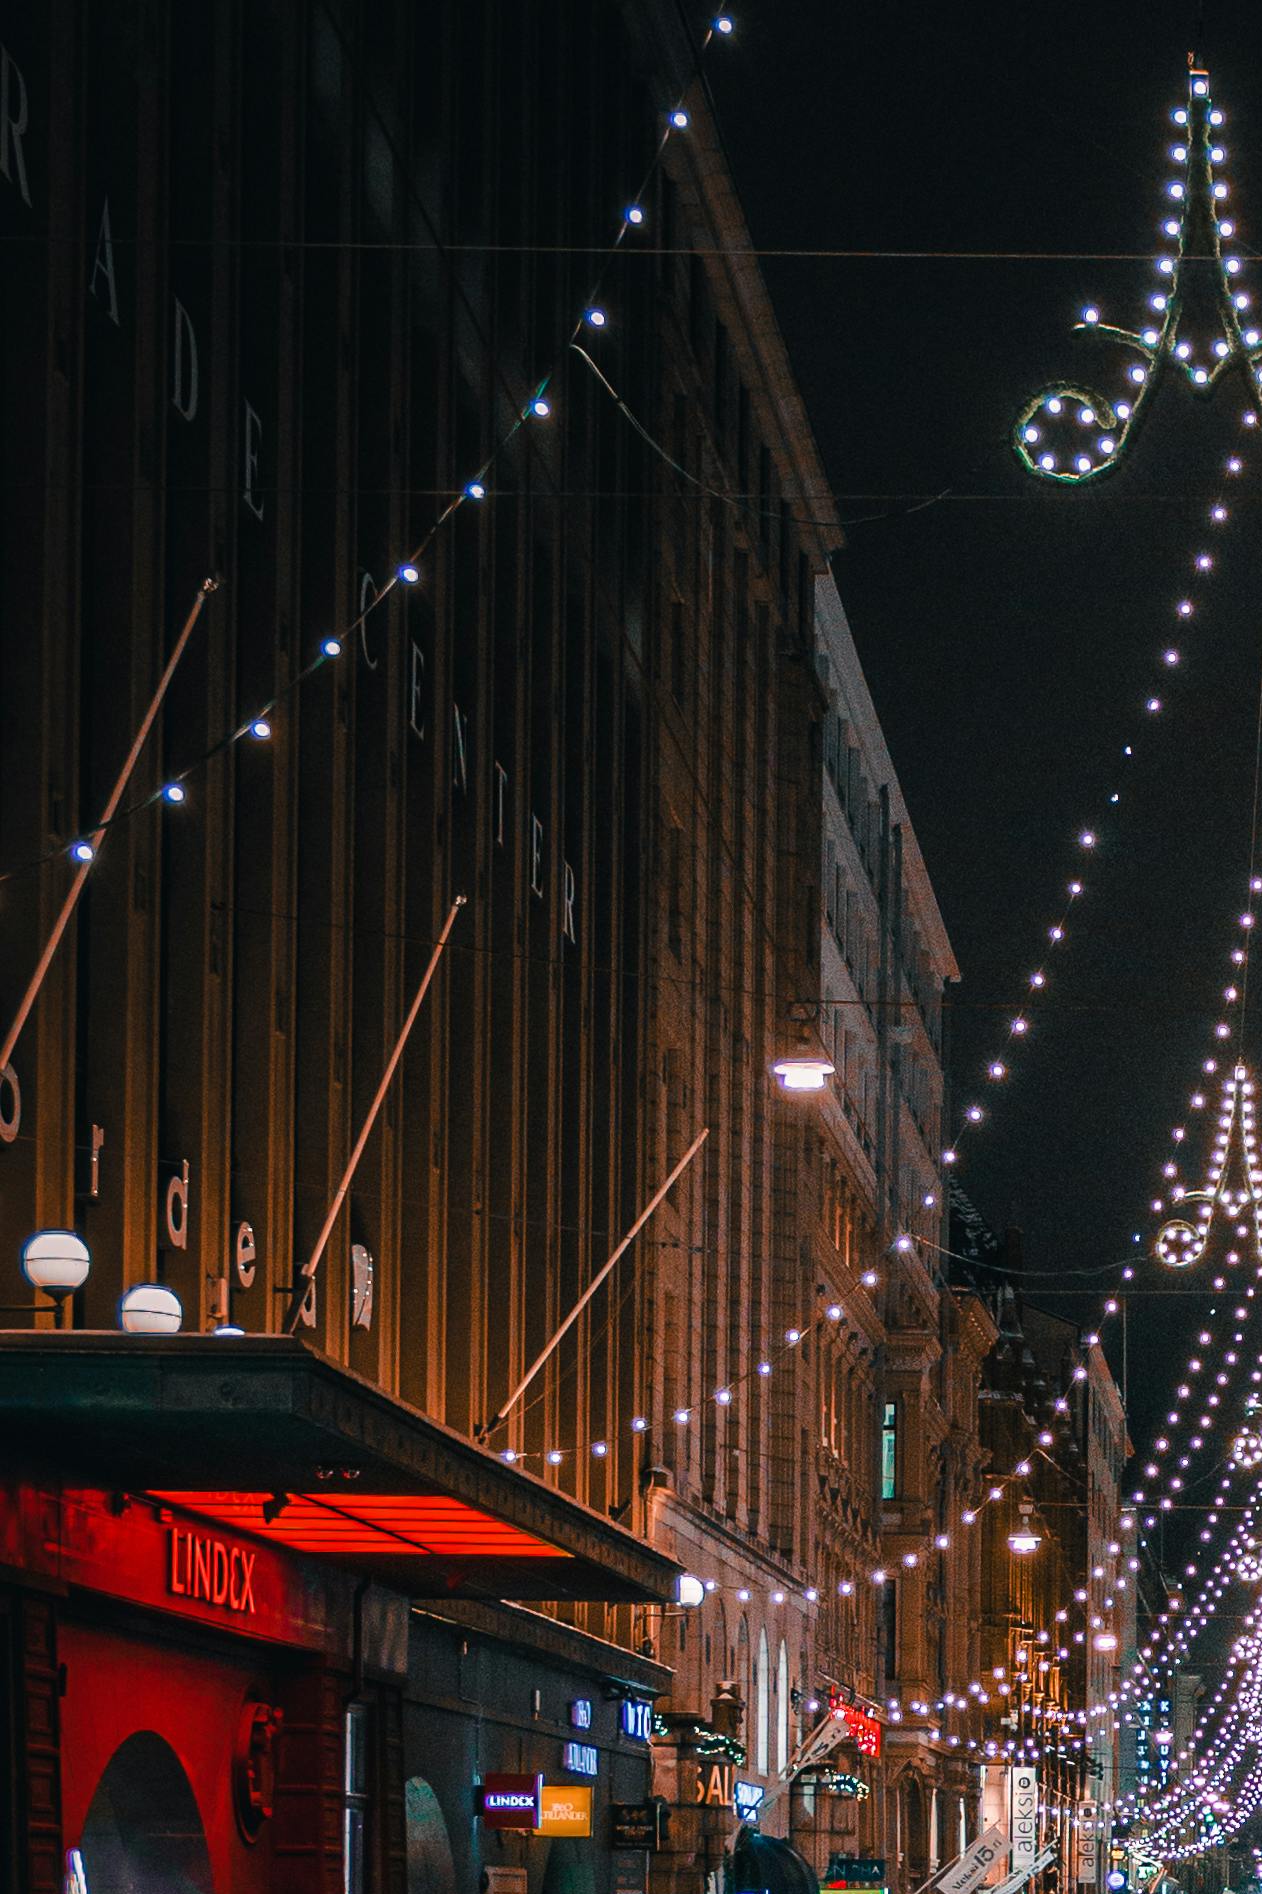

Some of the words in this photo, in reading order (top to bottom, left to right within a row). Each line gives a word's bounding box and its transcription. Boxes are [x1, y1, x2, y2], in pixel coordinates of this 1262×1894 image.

[359, 567, 576, 944] CENTER
[169, 1528, 257, 1614] LINDEX
[489, 1795, 535, 1808] LINDEX
[1014, 1791, 1034, 1853] aleksi
